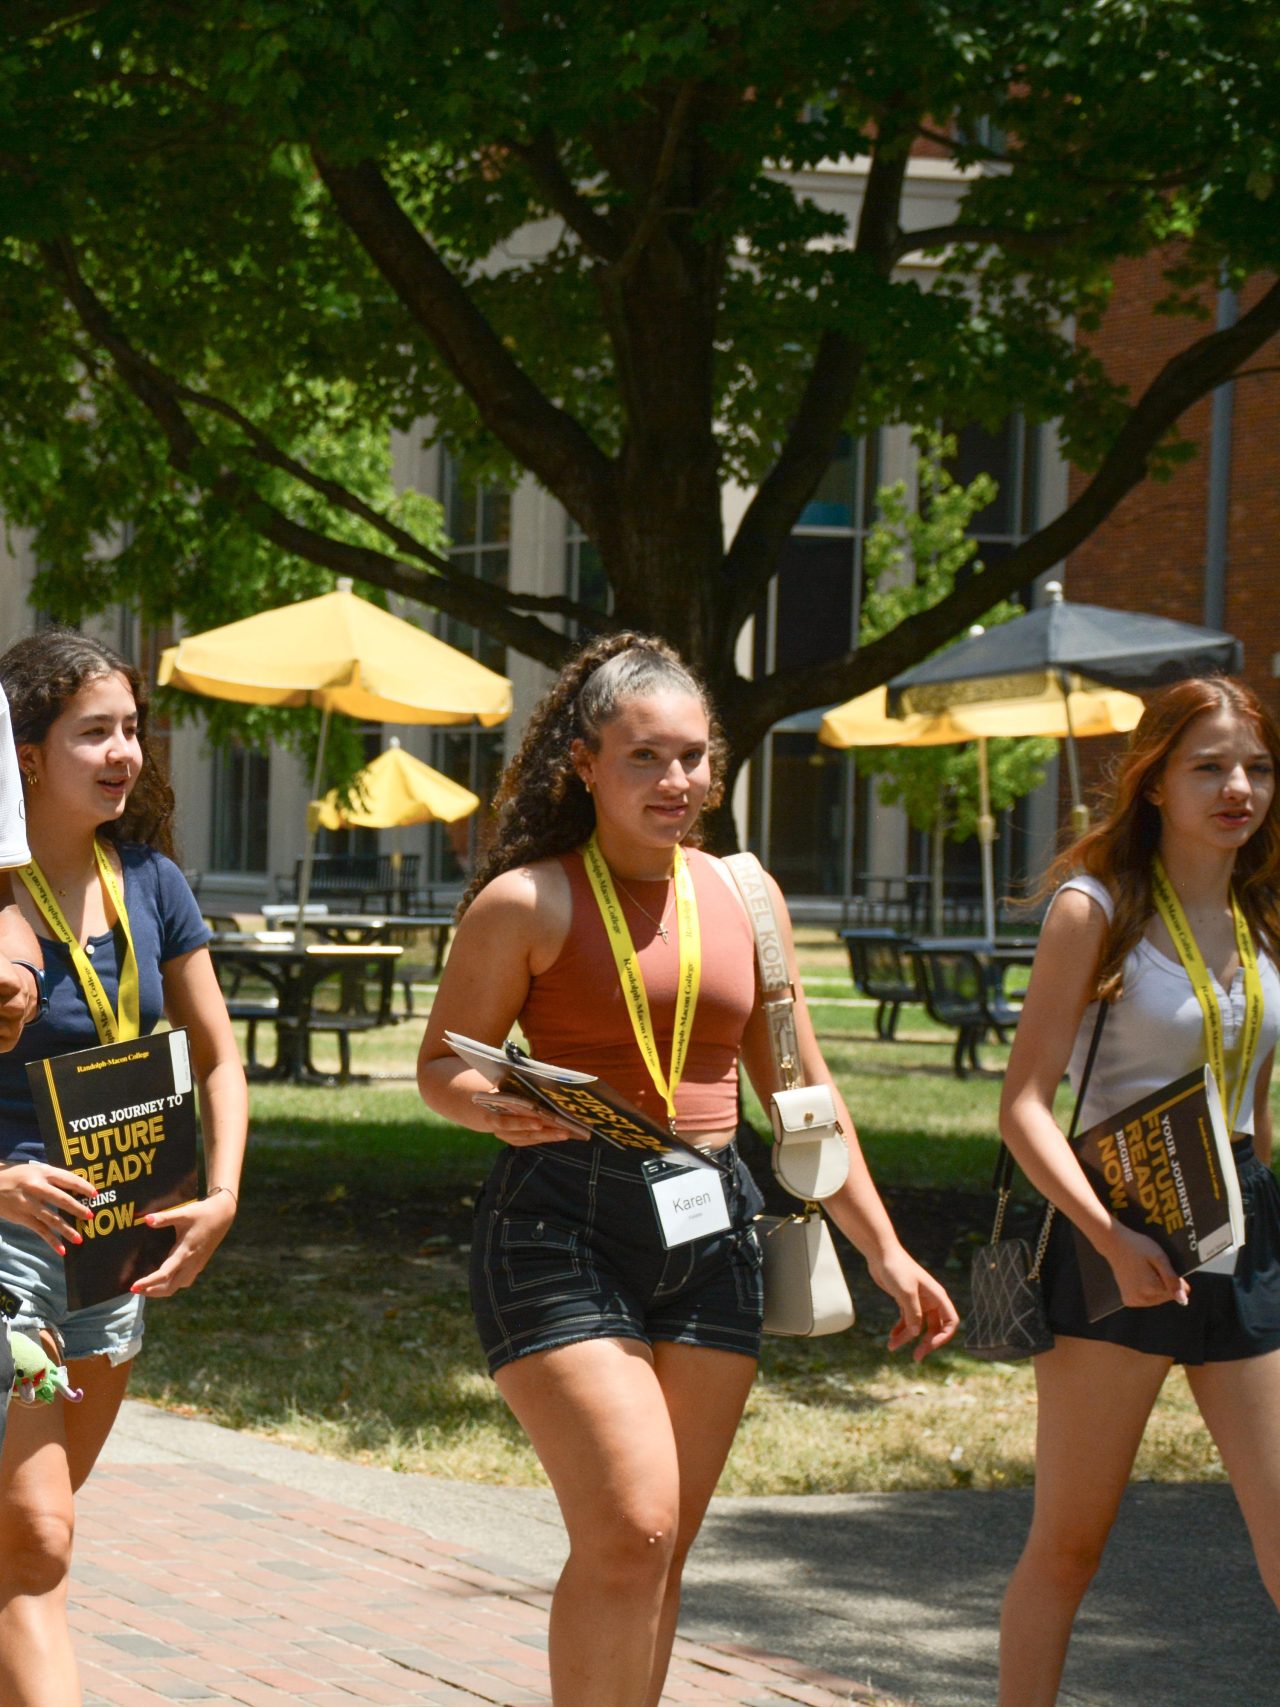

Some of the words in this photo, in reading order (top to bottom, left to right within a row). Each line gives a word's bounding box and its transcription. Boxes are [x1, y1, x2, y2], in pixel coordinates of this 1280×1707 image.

[30, 873, 73, 944] Randolph-Macon
[607, 905, 621, 935] College
[623, 958, 646, 1035] Randolph-Macon
[674, 995, 693, 1075] Randolph-Macon
[685, 962, 694, 995] College
[76, 1056, 129, 1074] Randolph-Macon
[127, 1051, 150, 1064] College
[69, 1113, 108, 1133] YOUR
[109, 1098, 165, 1123] JOURNEY
[167, 1094, 183, 1108] TO
[540, 1087, 578, 1115] AS
[560, 1086, 642, 1134] FIRST
[65, 1115, 166, 1166] FUTURE
[1115, 1129, 1134, 1183] BEGINS
[1123, 1119, 1164, 1226] READY
[1142, 1112, 1185, 1234] FUTURE
[1160, 1114, 1176, 1158] YOUR
[1170, 1159, 1194, 1227] JOURNEY
[1187, 1228, 1199, 1252] TO
[673, 1192, 712, 1214] Karen
